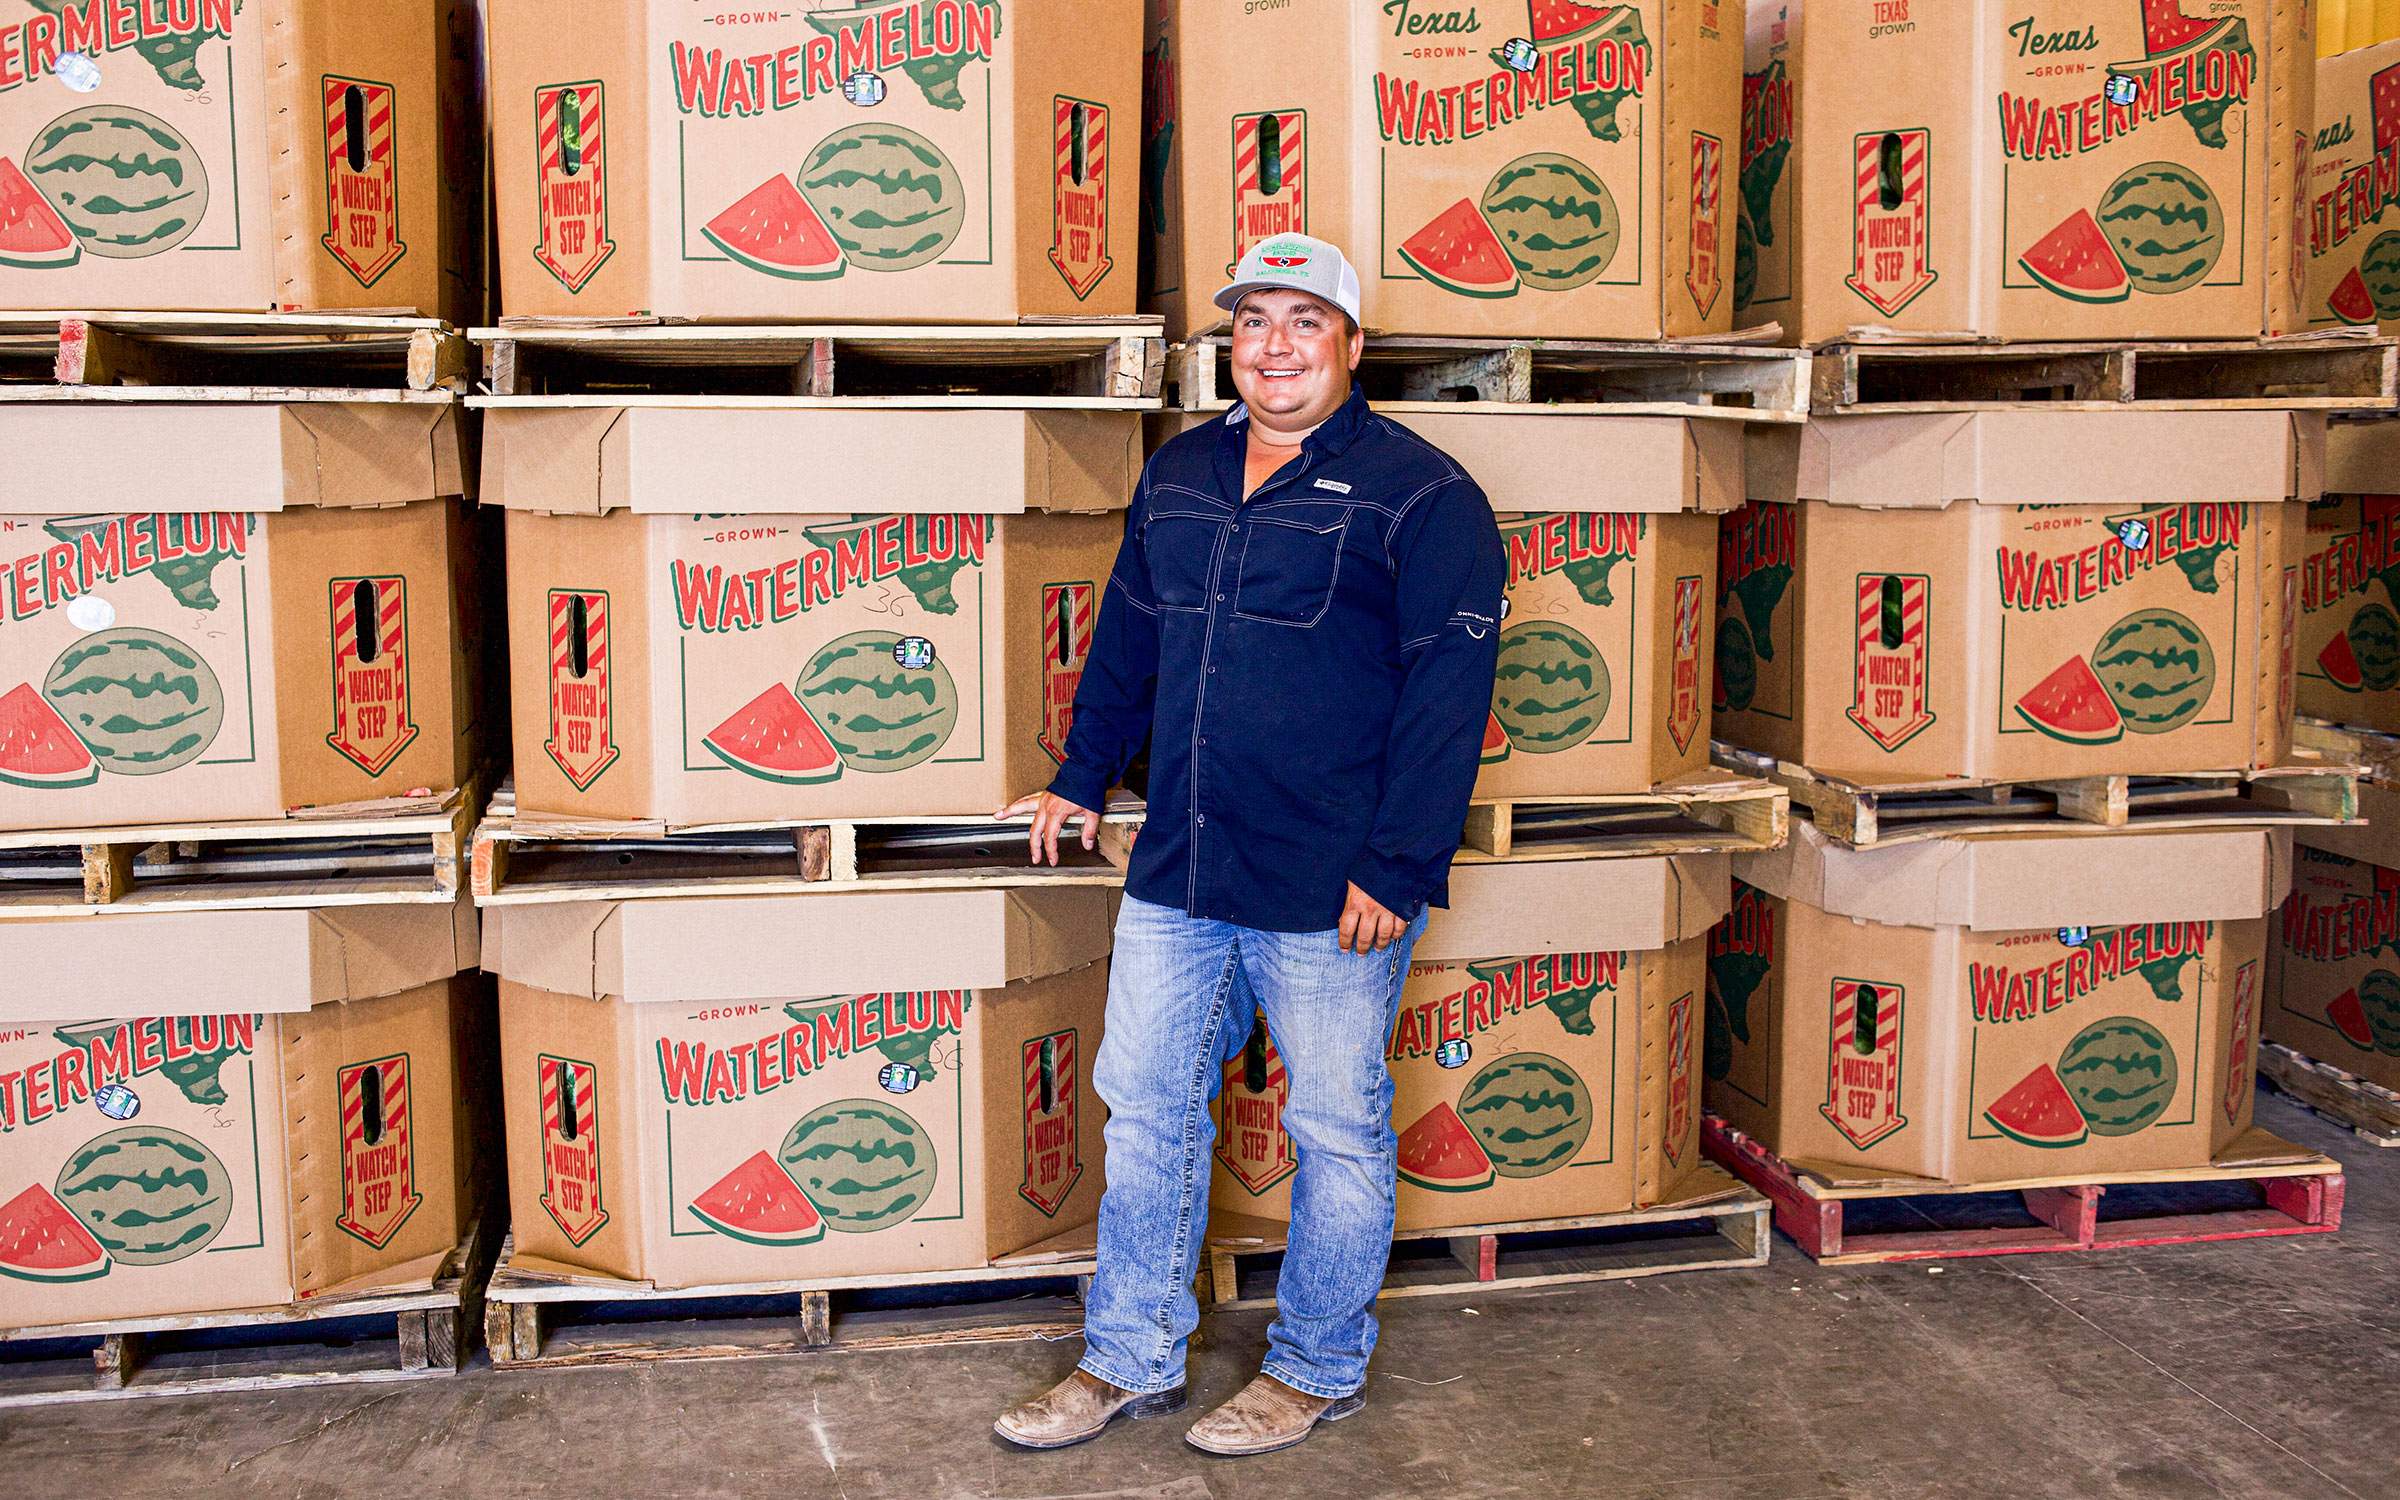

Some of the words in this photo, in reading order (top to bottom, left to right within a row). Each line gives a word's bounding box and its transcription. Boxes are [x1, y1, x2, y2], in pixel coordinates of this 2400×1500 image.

[715, 11, 778, 26] GROWN
[1383, 0, 1481, 37] Texas
[1873, 0, 1908, 24] TEXAS
[1869, 22, 1916, 39] grown
[2009, 16, 2099, 58] Texas
[669, 0, 993, 119] WATERMELON
[1412, 46, 1466, 59] GROWN
[2035, 62, 2085, 78] GROWN
[1374, 42, 1645, 147] WATERMELON
[1999, 48, 2249, 162] WATERMELON
[340, 173, 383, 212] WATCH
[551, 181, 591, 217] WATCH
[1064, 190, 1096, 228] WATCH
[349, 212, 378, 250] STEP
[1248, 202, 1289, 237] WATCH
[1868, 215, 1912, 249] WATCH
[559, 219, 586, 256] STEP
[1070, 229, 1090, 264] STEP
[1875, 250, 1905, 284] STEP
[715, 526, 777, 544] GROWN
[2033, 516, 2083, 532] GROWN
[670, 513, 985, 633] WATERMELON
[1996, 503, 2240, 613] WATERMELON
[862, 585, 912, 617] 36
[1523, 590, 1570, 615] 36
[348, 668, 393, 705] WATCH
[1868, 654, 1912, 687] WATCH
[561, 682, 598, 720] WATCH
[1874, 687, 1905, 720] STEP
[357, 706, 388, 741] STEP
[567, 719, 593, 756] STEP
[2004, 931, 2051, 948] GROWN
[1969, 921, 2205, 1023] WATERMELON
[699, 1004, 759, 1021] GROWN
[1384, 950, 1621, 1062] ATERMELON
[657, 988, 964, 1106] WATERMELON
[925, 1038, 965, 1071] 36
[1482, 1032, 1519, 1056] 36
[1842, 1055, 1885, 1090] WATCH
[1234, 1095, 1276, 1132] WATCH
[1847, 1087, 1877, 1121] STEP
[1034, 1115, 1066, 1153] WATCH
[1241, 1129, 1270, 1164] STEP
[356, 1143, 398, 1186] WATCH
[553, 1142, 588, 1182] WATCH
[1039, 1150, 1062, 1188] STEP
[364, 1183, 392, 1218] STEP
[560, 1175, 585, 1214] STEP
